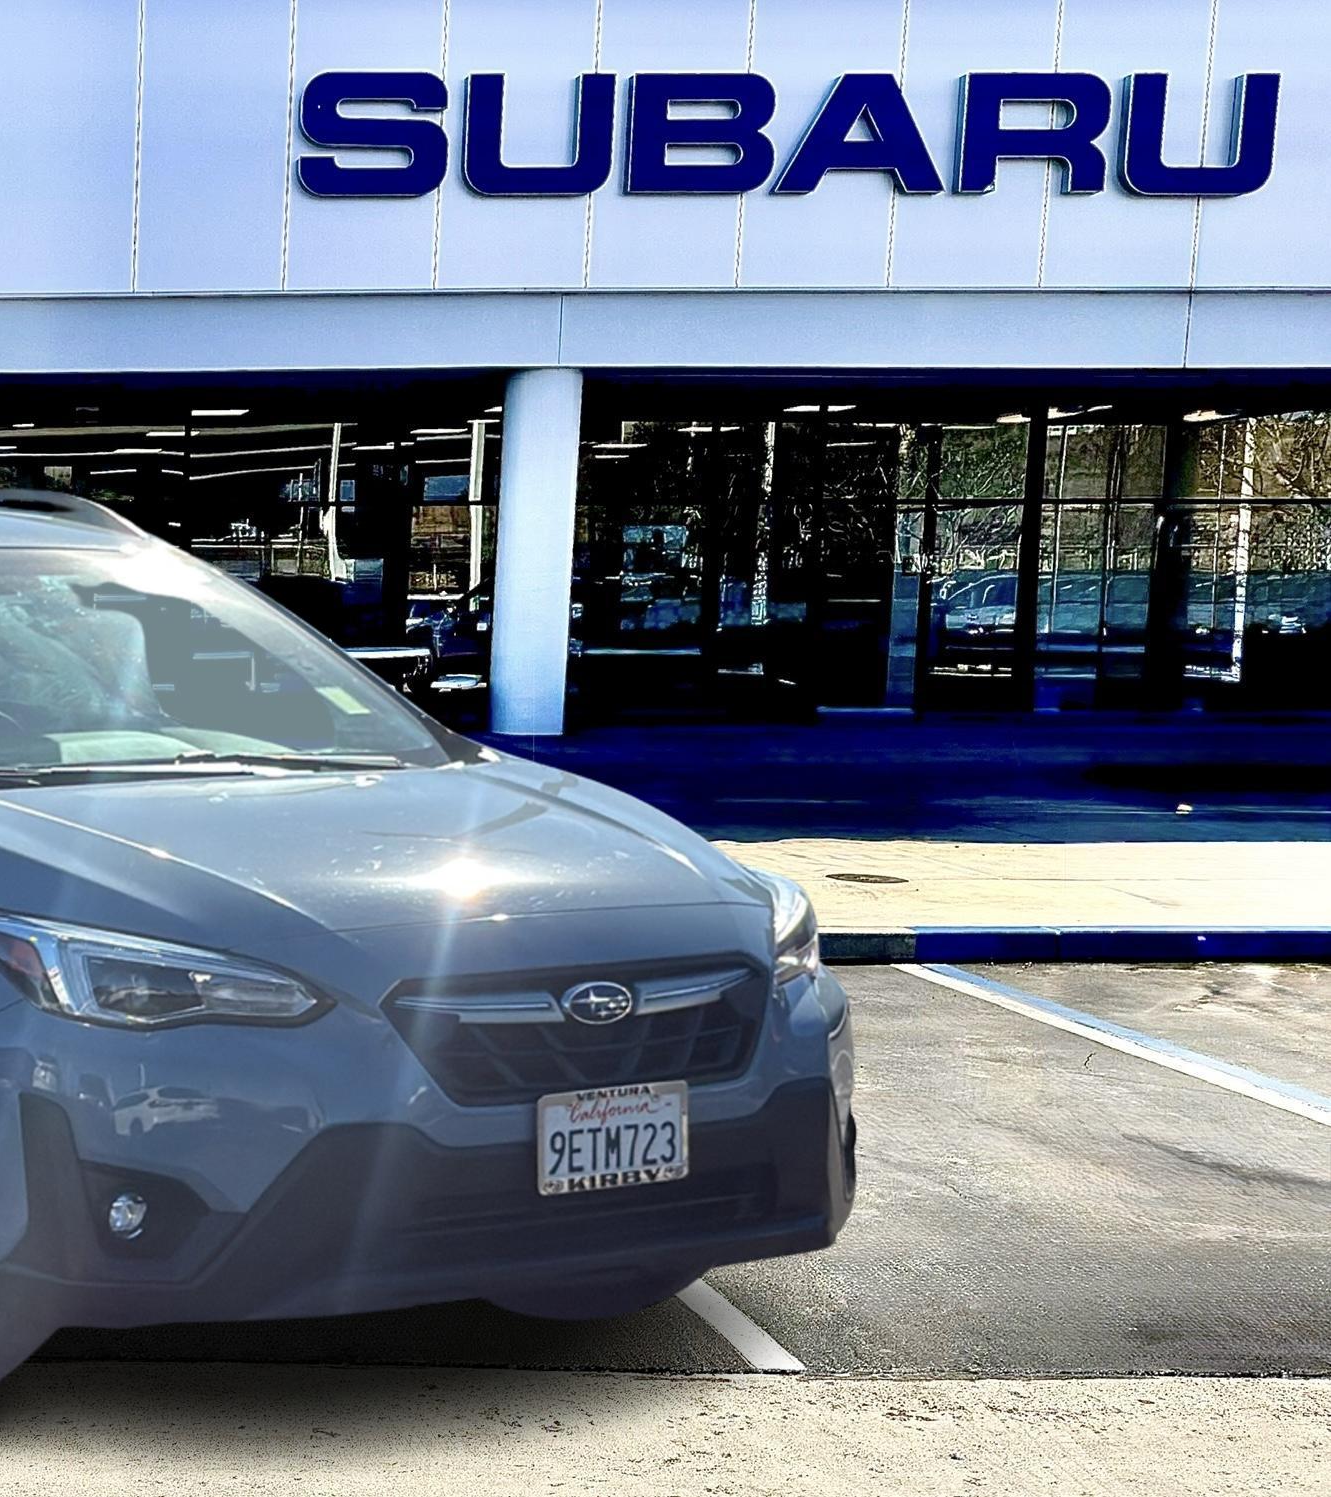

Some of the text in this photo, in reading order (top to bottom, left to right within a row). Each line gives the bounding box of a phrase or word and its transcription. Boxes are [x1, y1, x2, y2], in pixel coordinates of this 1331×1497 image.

[297, 71, 1281, 196] SUBARU
[576, 1085, 652, 1101] VENTURA
[568, 1100, 659, 1125] California
[549, 1121, 676, 1175] 9ETM723
[568, 1168, 662, 1192] KIRBY
